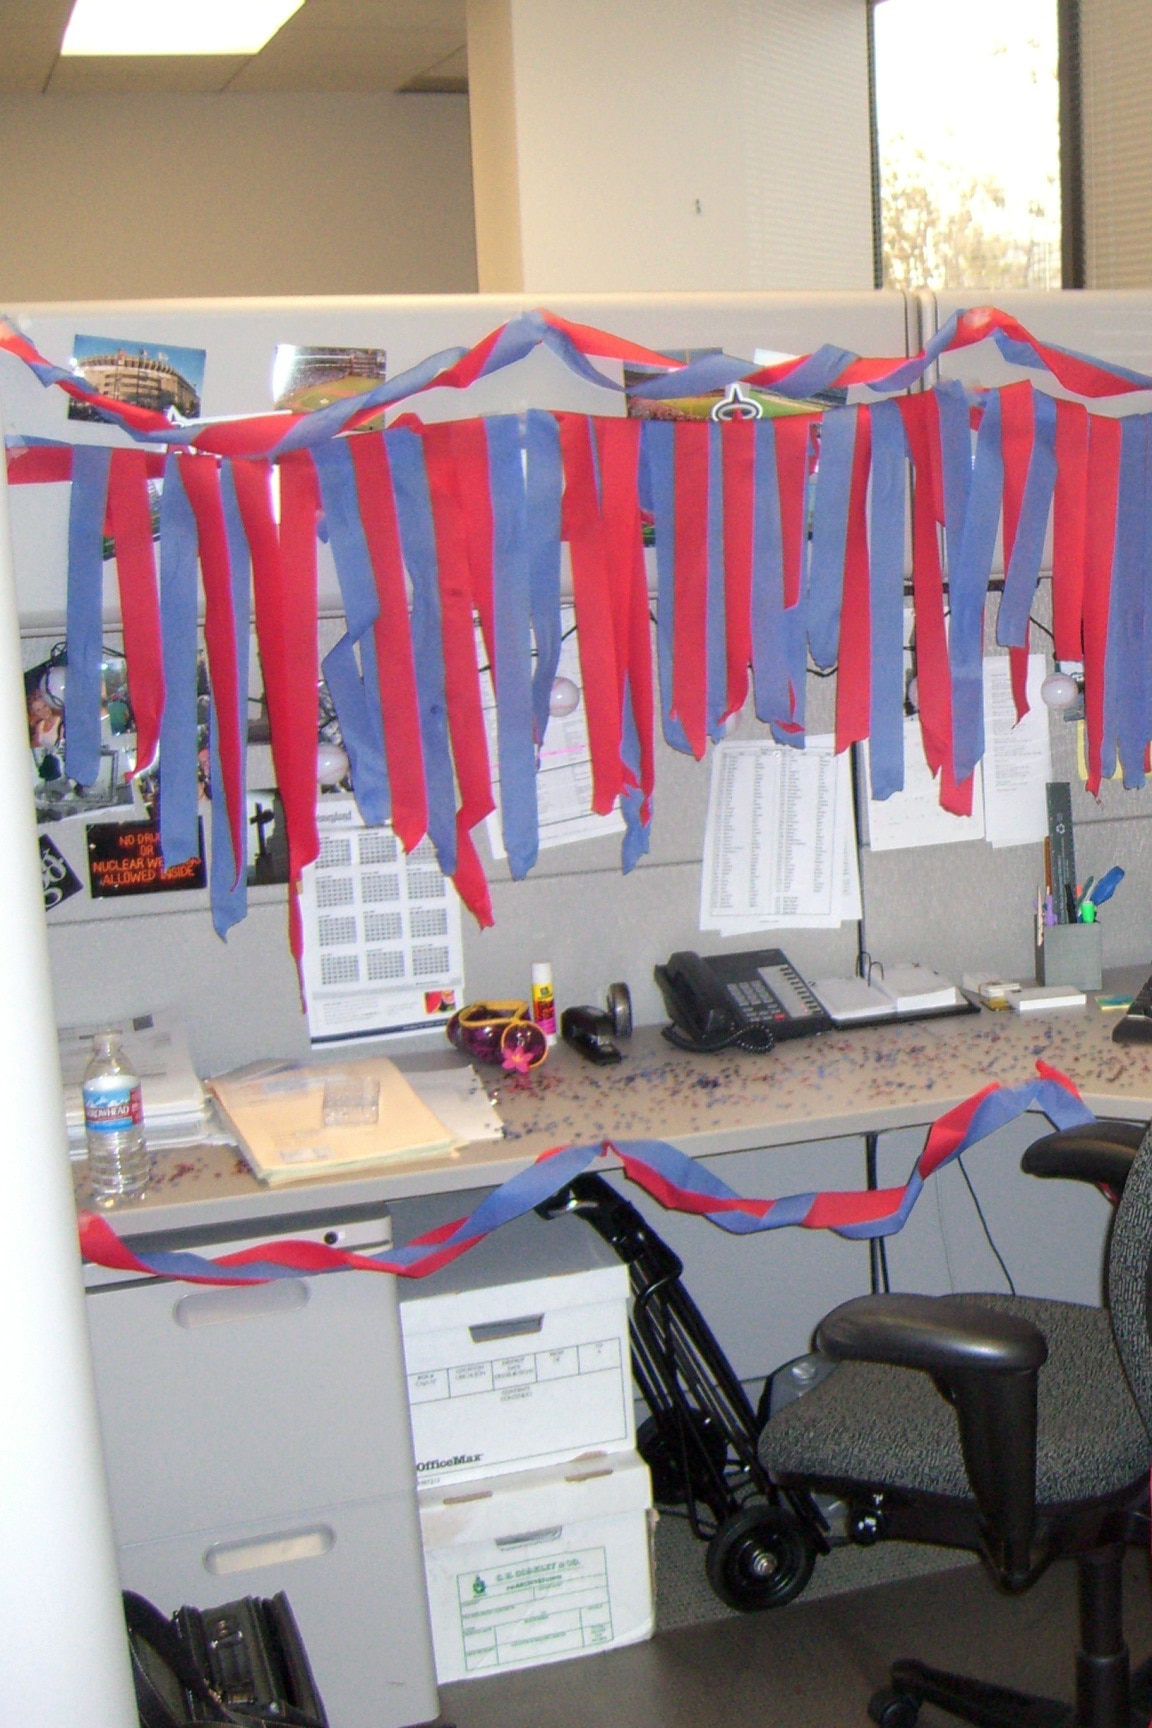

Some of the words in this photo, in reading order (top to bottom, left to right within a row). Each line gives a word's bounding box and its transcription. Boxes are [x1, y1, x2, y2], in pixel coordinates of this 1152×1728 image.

[119, 836, 135, 846] NO
[137, 832, 161, 844] DRU
[140, 845, 154, 856] OR
[92, 859, 144, 872] NUCLEAR
[102, 870, 156, 885] ALLOWED
[416, 1454, 482, 1472] OfficeMax
